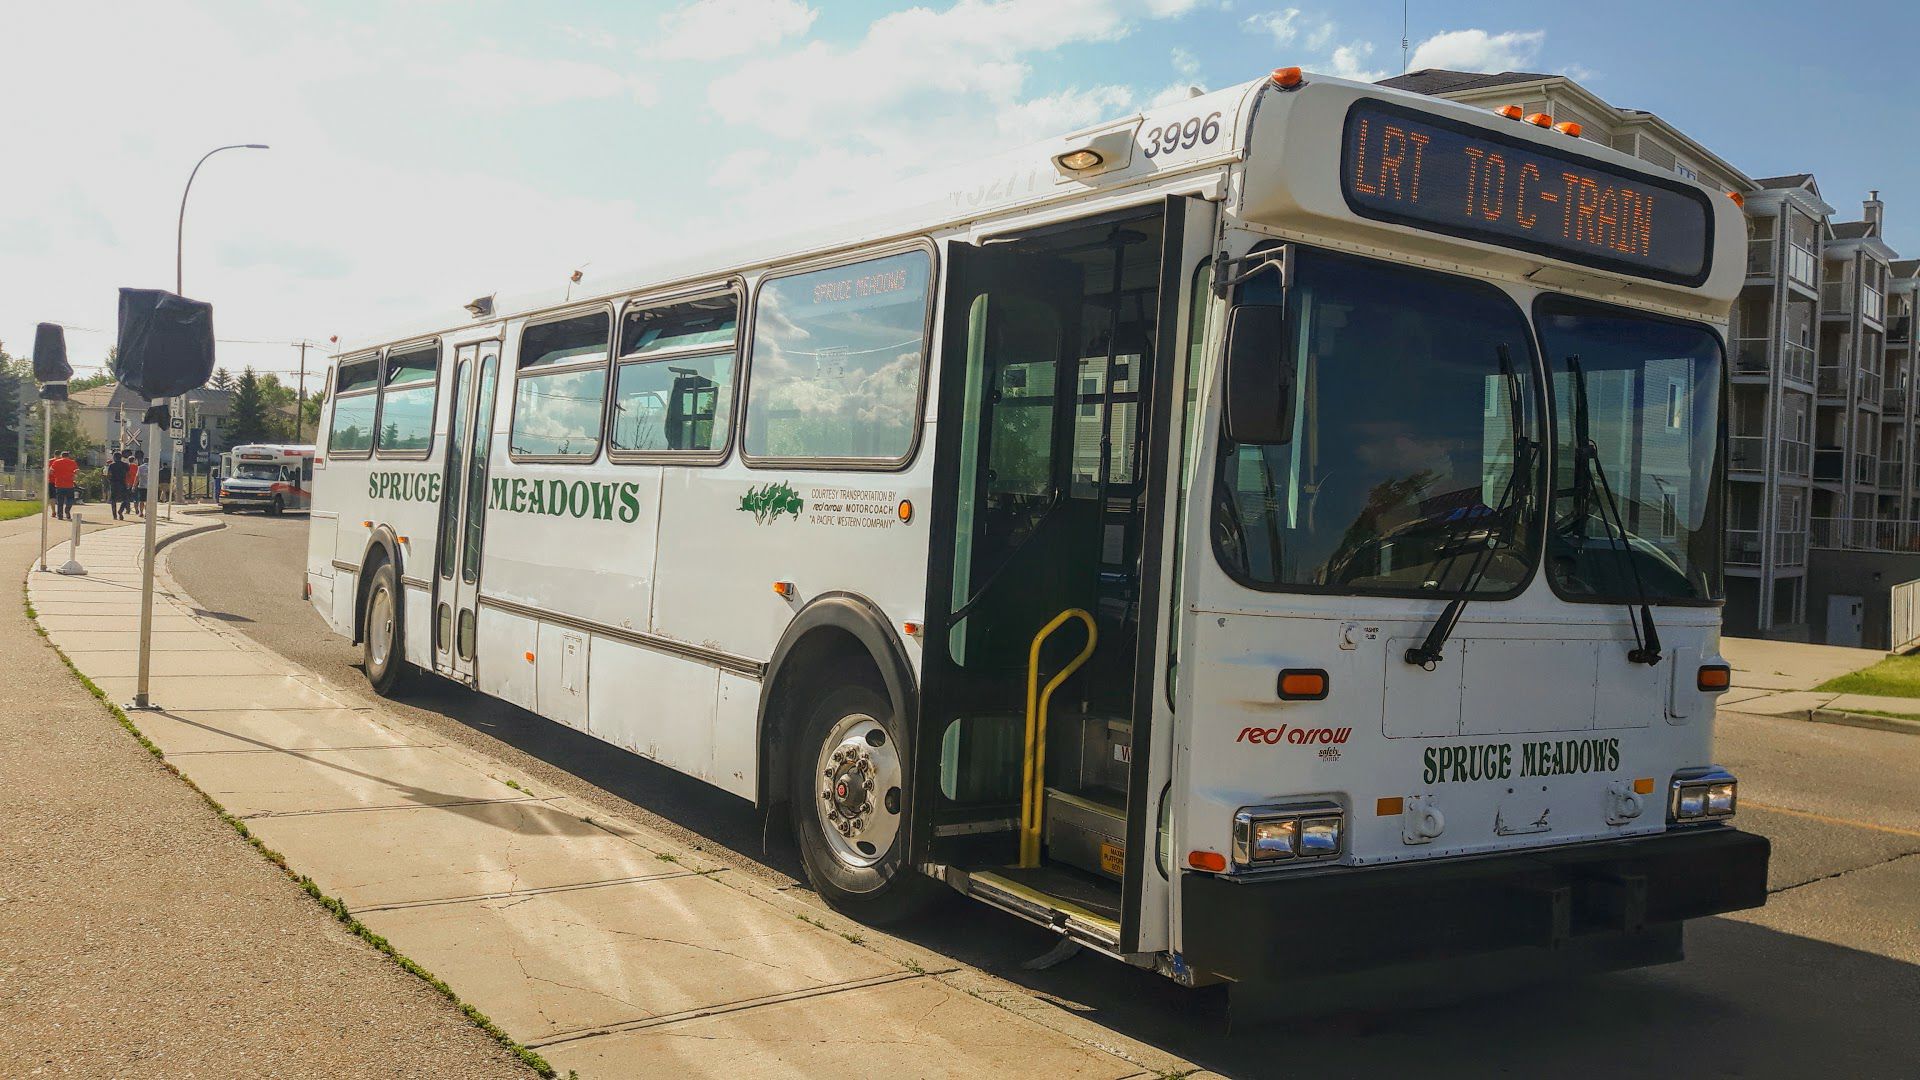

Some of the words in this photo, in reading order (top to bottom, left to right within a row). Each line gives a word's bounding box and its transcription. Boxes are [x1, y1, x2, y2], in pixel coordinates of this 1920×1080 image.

[1143, 111, 1222, 159] 3996
[1356, 119, 1430, 203] LRT
[1465, 147, 1506, 221] TO
[1516, 162, 1653, 257] C-TRAIN
[813, 279, 852, 304] SPRUCE
[855, 269, 906, 298] MEADOWS
[368, 471, 441, 503] SPRUCE
[488, 477, 641, 524] MEADOWS
[811, 488, 839, 500] COURTESY
[840, 489, 887, 502] TRANSPORTATION
[888, 490, 897, 502] BY
[845, 503, 894, 515] MOTORCOACH
[816, 515, 835, 526] PACIFIC
[837, 516, 861, 528] WESTERN
[862, 517, 896, 529] COMPANY"
[1236, 723, 1288, 745] red
[1287, 727, 1353, 745] arrow
[1423, 743, 1512, 785] SPRUCE
[1519, 737, 1620, 779] MEADOWS
